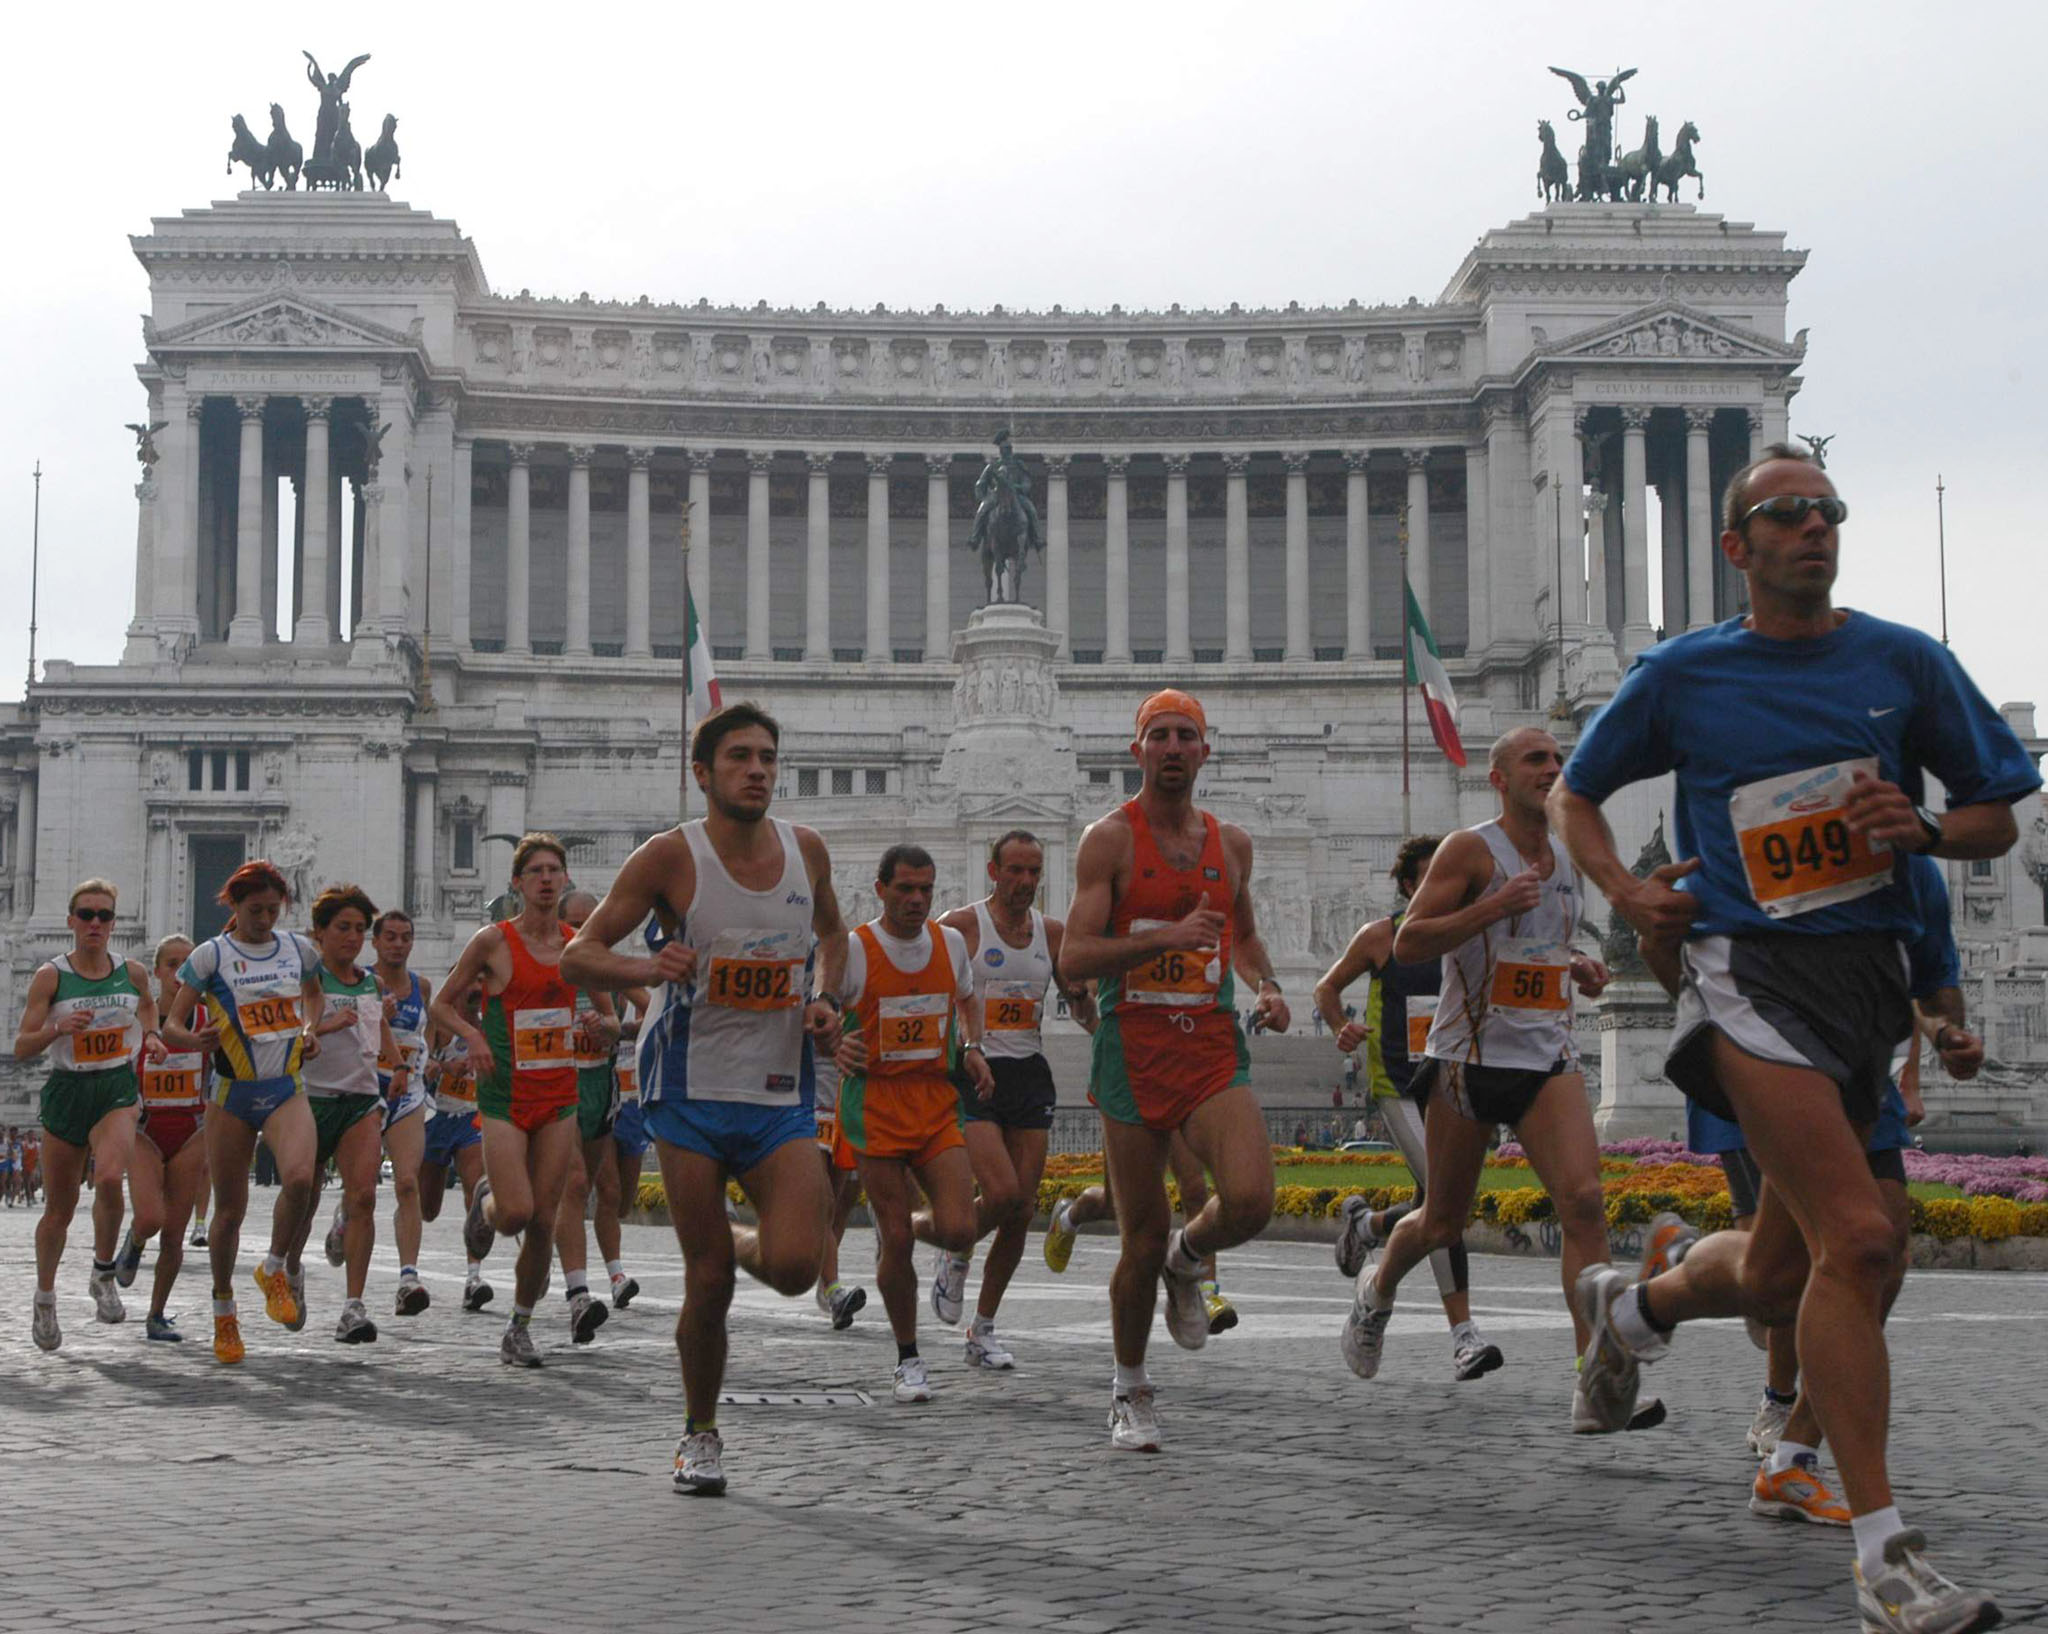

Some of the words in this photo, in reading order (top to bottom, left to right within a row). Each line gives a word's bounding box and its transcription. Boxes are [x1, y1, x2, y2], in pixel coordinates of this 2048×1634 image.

[210, 372, 278, 386] PATRIAE
[293, 372, 357, 386] VNITATI
[1595, 382, 1651, 395] CIVIVM
[1664, 383, 1741, 396] LIBERTATI
[1762, 818, 1850, 881] 949
[233, 973, 279, 987] FONDIARIA
[1151, 953, 1185, 984] 36
[714, 963, 791, 999] 1982
[1513, 970, 1545, 999] 56
[247, 1000, 291, 1027] 104
[998, 1002, 1022, 1024] 25
[532, 1031, 555, 1053] 17
[897, 1020, 924, 1044] 32
[82, 1033, 118, 1056] 102
[153, 1074, 186, 1093] 101
